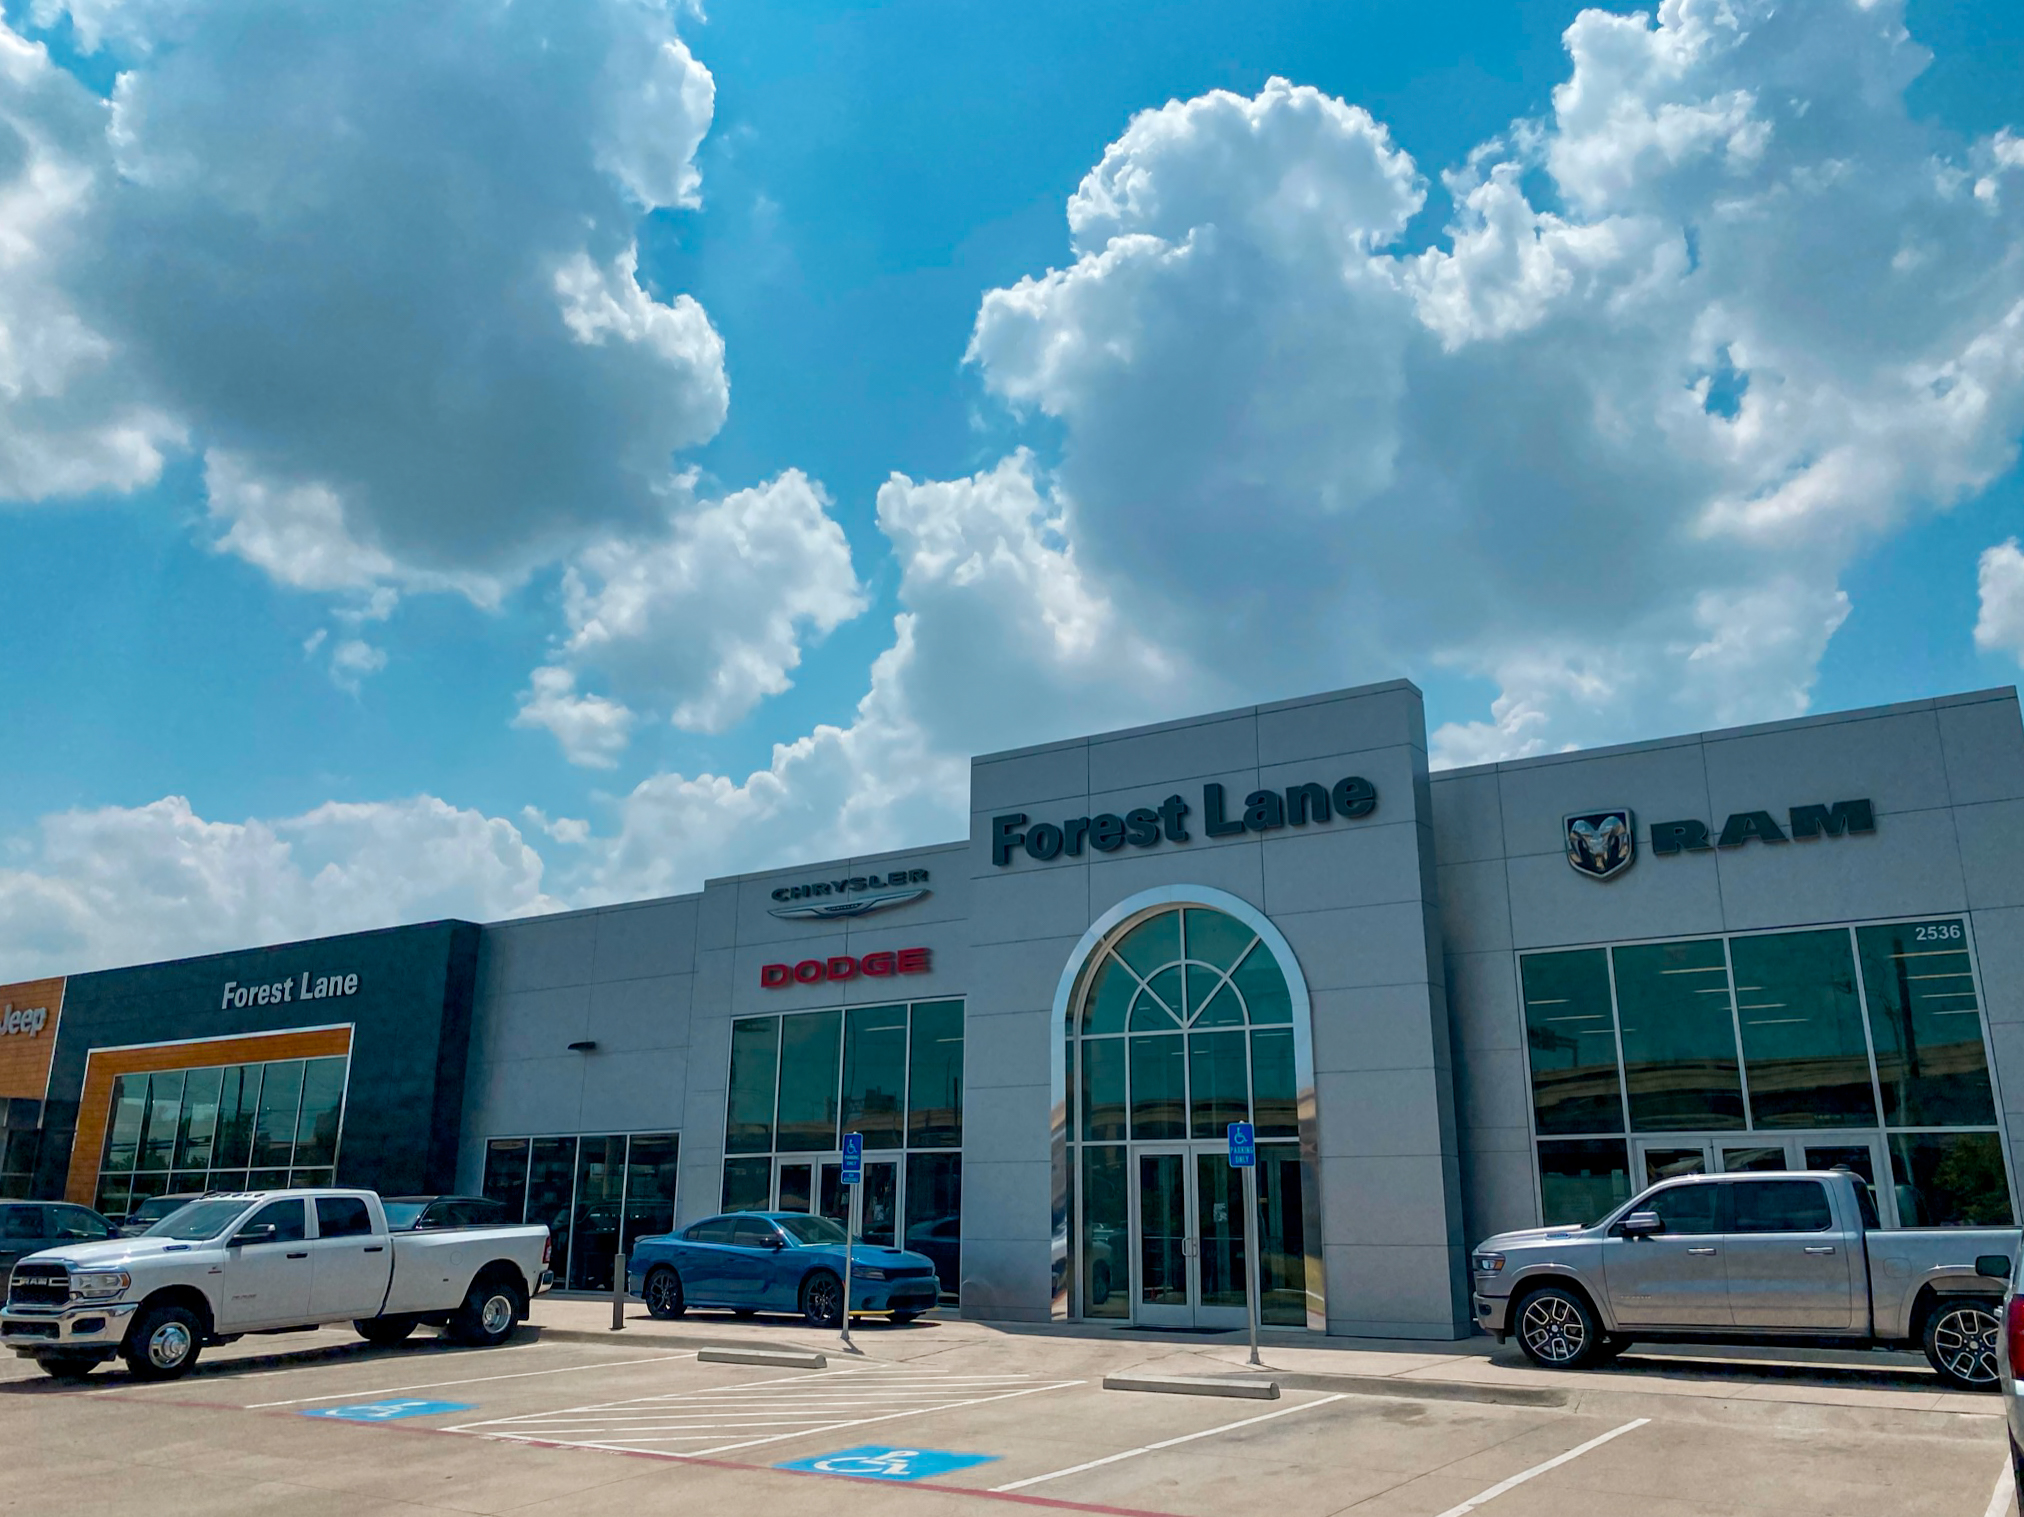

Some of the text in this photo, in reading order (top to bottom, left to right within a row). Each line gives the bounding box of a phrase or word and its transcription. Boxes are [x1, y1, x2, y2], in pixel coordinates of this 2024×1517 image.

[992, 776, 1377, 867] Forest Lane
[1650, 798, 1877, 856] RAM
[771, 868, 930, 902] CHRYSLER
[1915, 924, 1961, 941] 2536
[761, 947, 931, 988] DODGE
[221, 971, 358, 1010] Forest Lane
[0, 1003, 47, 1038] Jeep
[1230, 1146, 1254, 1154] PARKING
[1235, 1155, 1250, 1163] ONLY
